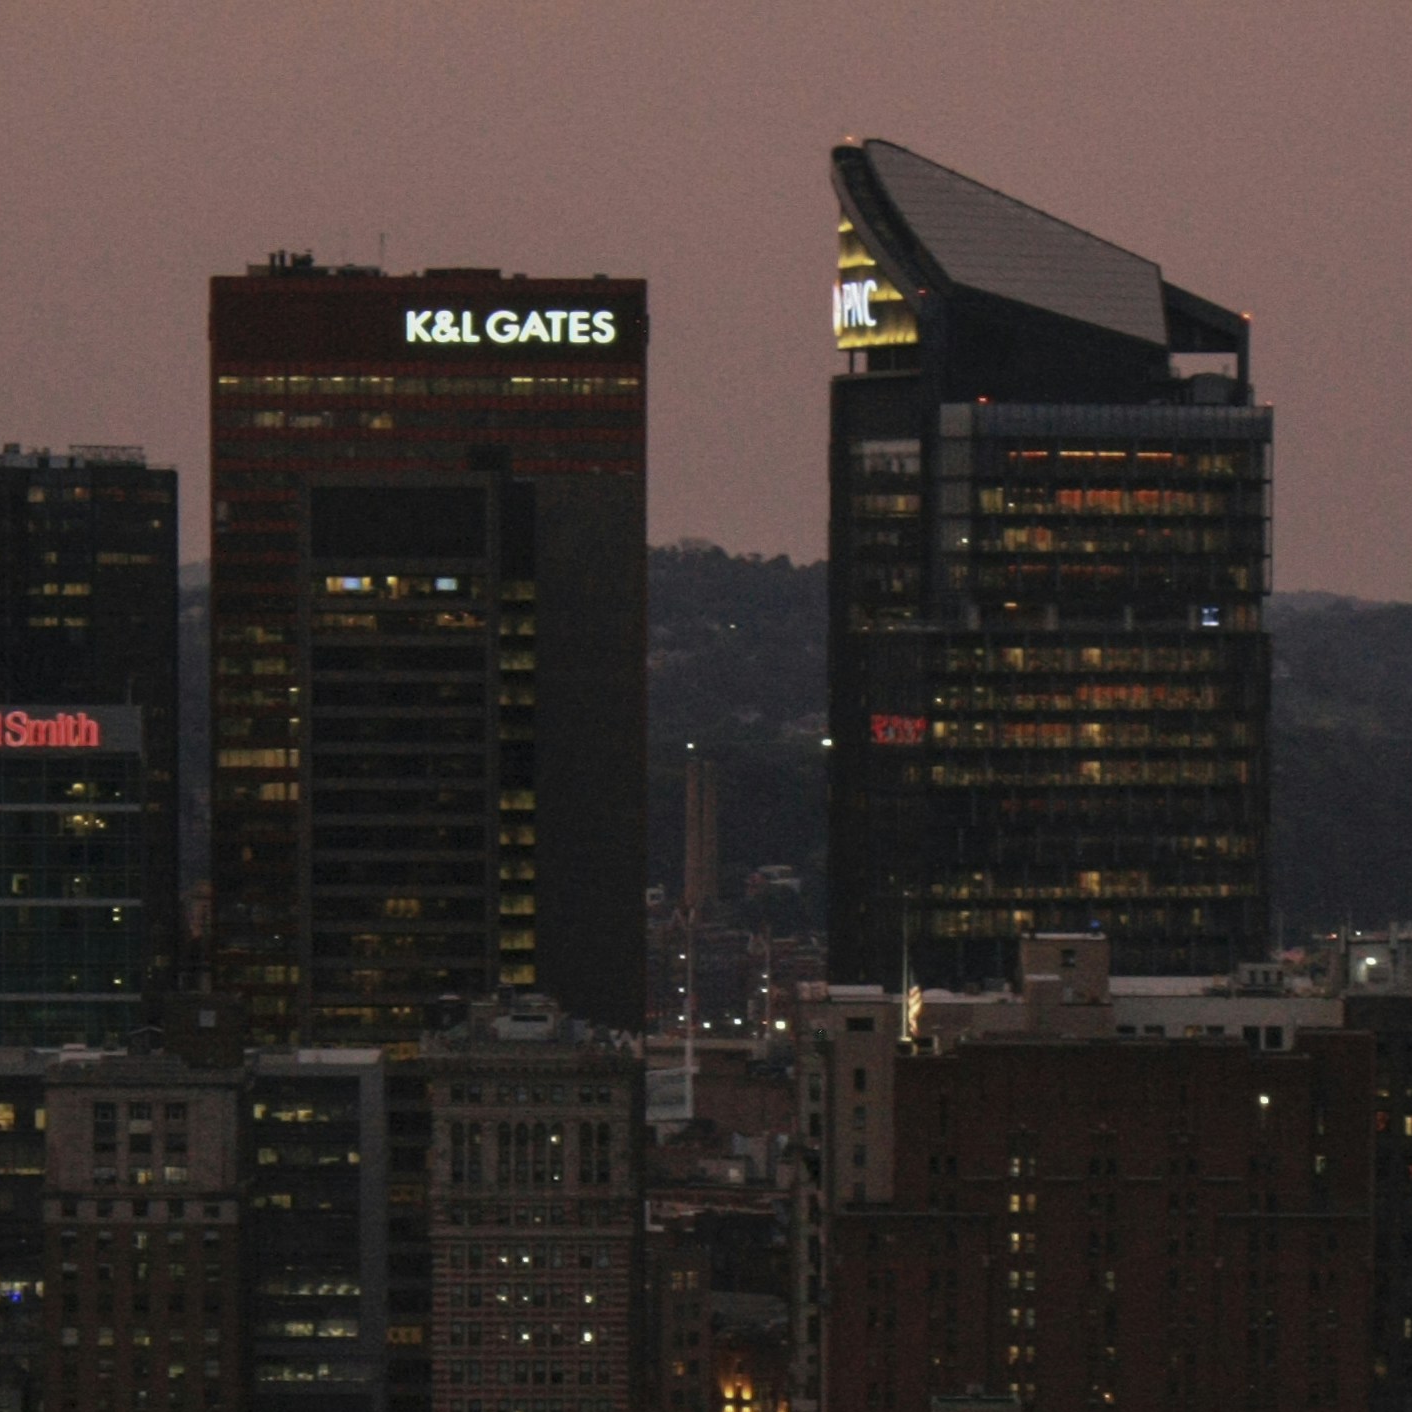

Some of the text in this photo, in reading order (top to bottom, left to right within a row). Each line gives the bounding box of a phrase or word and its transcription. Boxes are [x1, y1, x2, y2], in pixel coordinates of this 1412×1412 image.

[841, 280, 877, 328] PNC
[406, 310, 615, 343] K&L GATES
[4, 710, 99, 747] Smith
